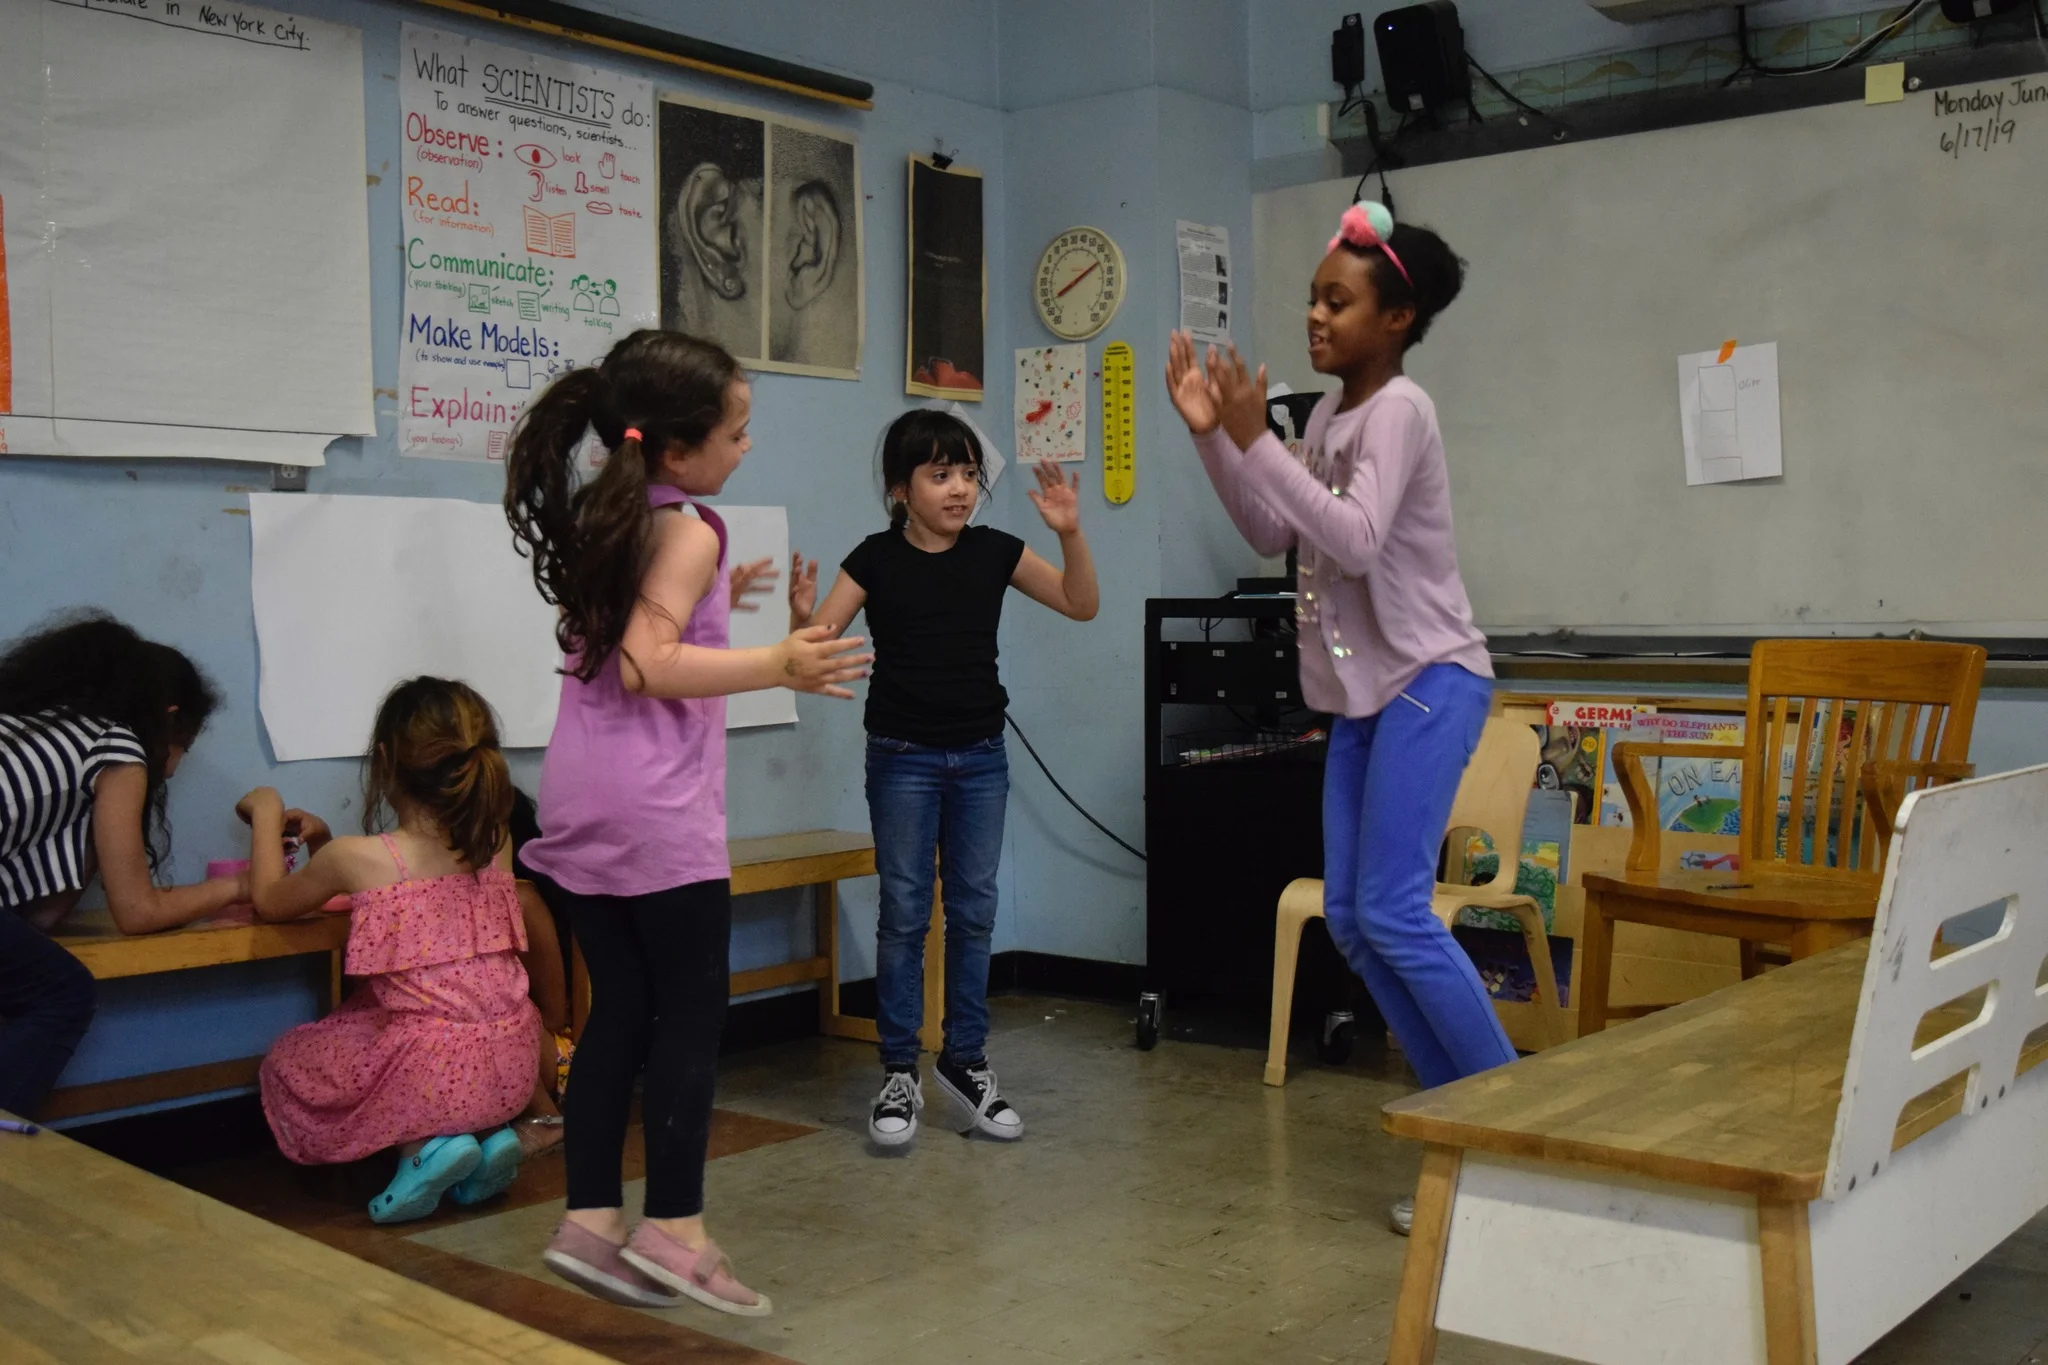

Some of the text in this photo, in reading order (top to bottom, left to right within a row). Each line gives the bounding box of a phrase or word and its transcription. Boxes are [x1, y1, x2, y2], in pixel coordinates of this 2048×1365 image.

[199, 5, 228, 27] New
[232, 13, 266, 34] York
[413, 47, 651, 128] What SCIENTISTS do:
[1935, 79, 2048, 123] Monday Jun
[434, 90, 637, 150] To answer questions, scientists...
[406, 111, 504, 158] Observe:
[1939, 117, 2016, 159] 6/17/19
[416, 144, 484, 173] (observation)
[562, 149, 581, 164] look
[544, 180, 567, 196] listen
[620, 170, 641, 184] touch
[407, 175, 480, 216] Read:
[589, 184, 610, 195] smell
[618, 208, 643, 219] taste
[439, 214, 495, 238] information)
[407, 237, 555, 288] Communicate:
[490, 296, 514, 308] sketch
[541, 301, 571, 322] writing
[409, 313, 560, 358] Make Models:
[583, 316, 613, 335] talking
[432, 352, 452, 365] show
[453, 356, 467, 366] and
[469, 358, 481, 367] use
[411, 386, 518, 428] Explain:
[1575, 706, 1632, 720] GERMS
[1637, 718, 1740, 731] WHY DO ELEPHANTS
[1667, 730, 1714, 740] THE SUN?
[1667, 763, 1703, 797] ON
